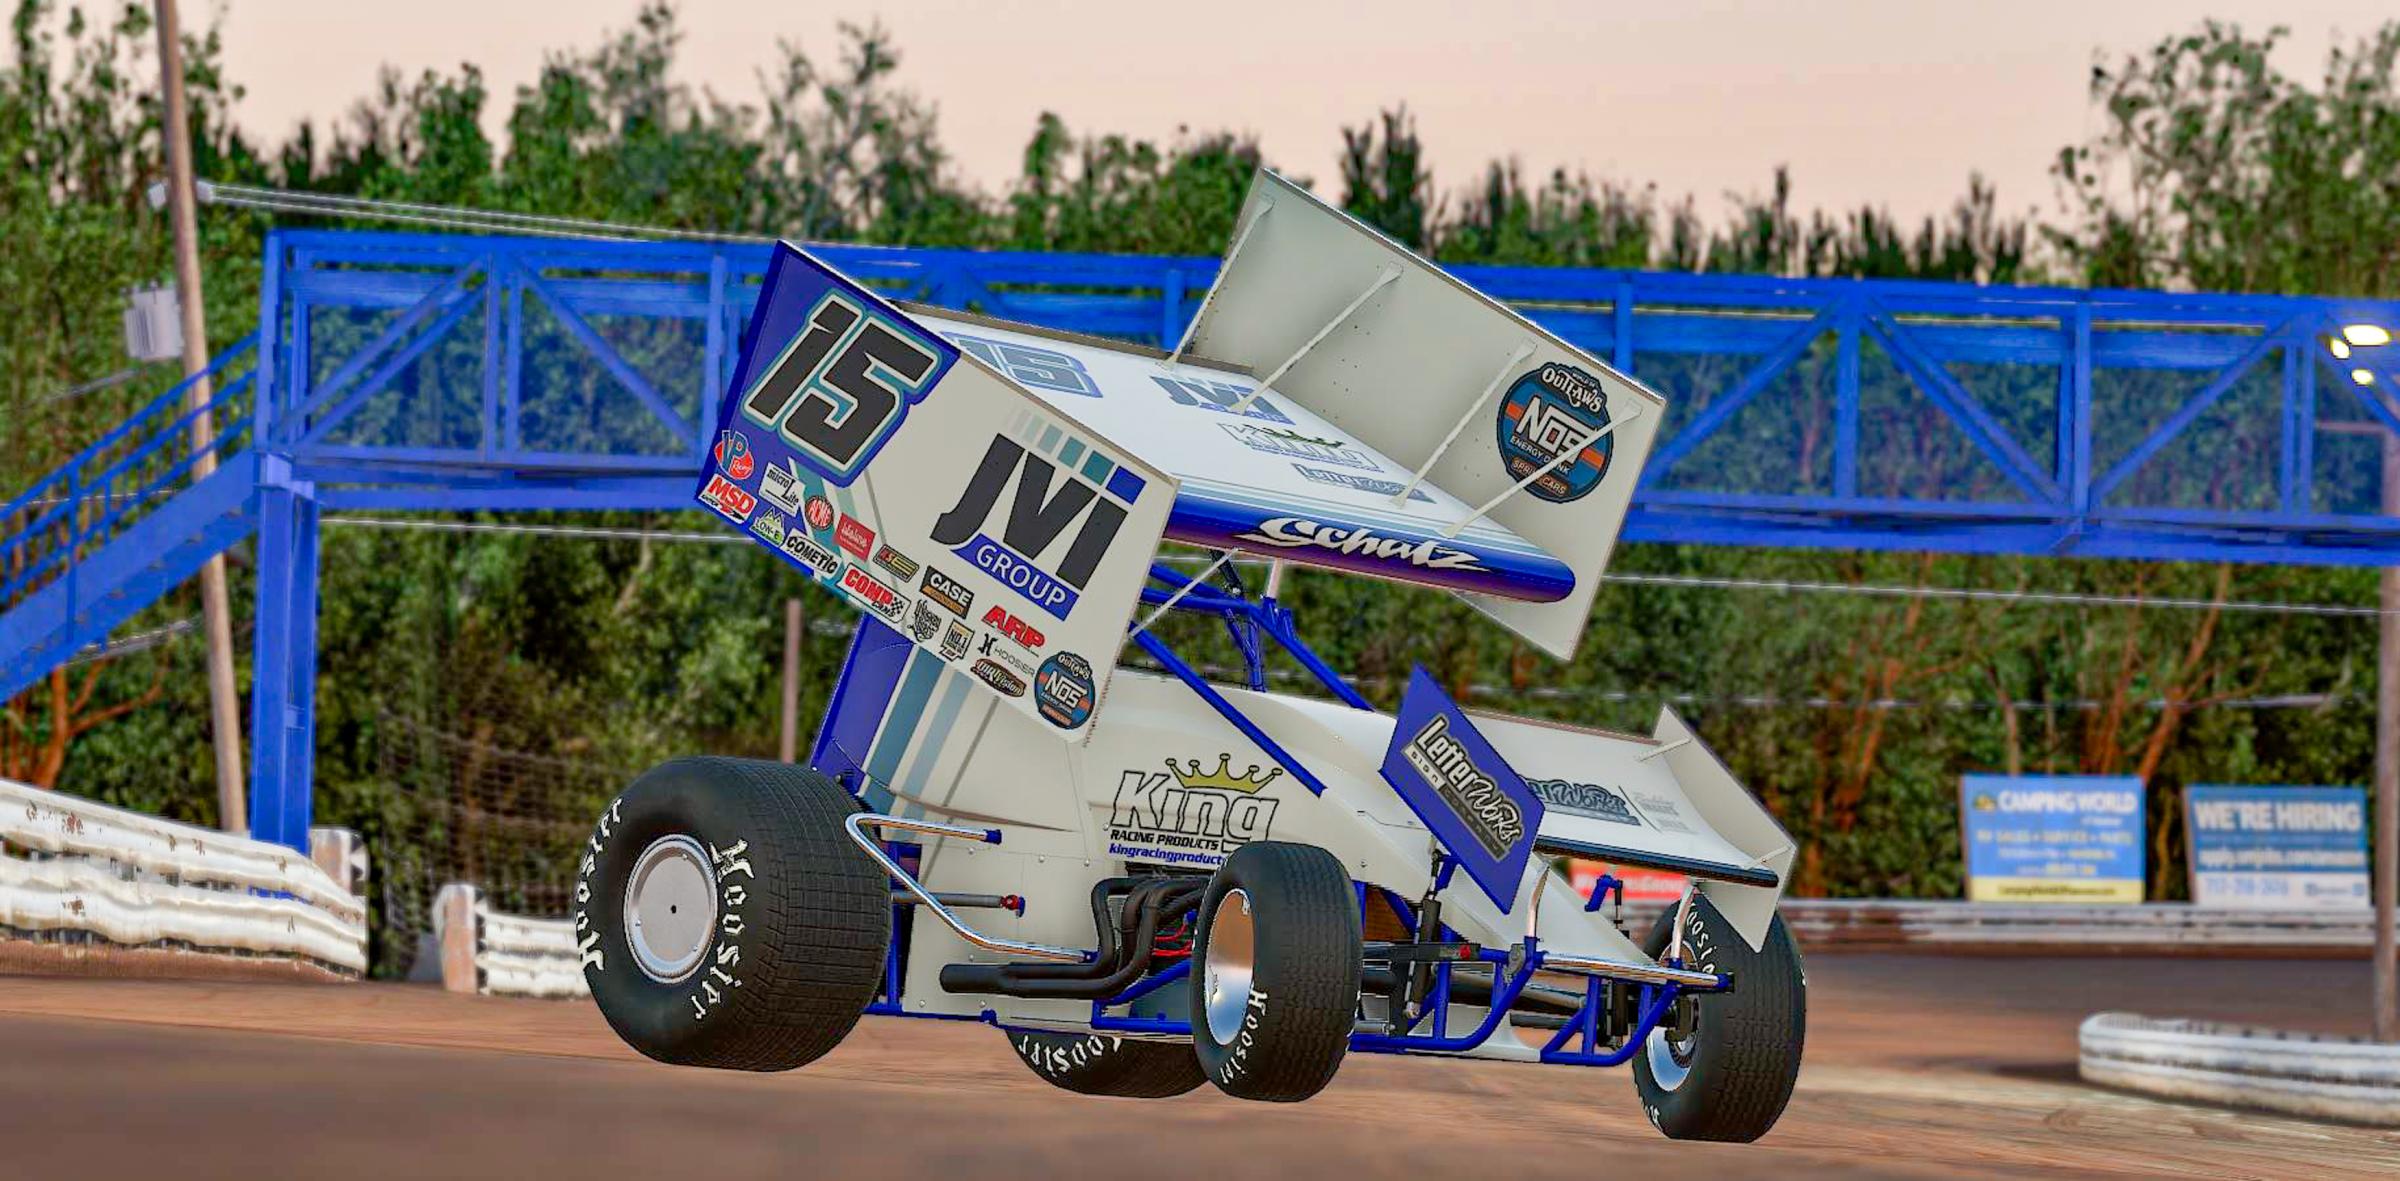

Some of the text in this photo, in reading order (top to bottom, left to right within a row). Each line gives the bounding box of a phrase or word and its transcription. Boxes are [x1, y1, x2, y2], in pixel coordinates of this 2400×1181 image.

[742, 291, 940, 473] 15
[1515, 396, 1598, 465] NOS
[1510, 435, 1571, 474] ENERGY DNK
[706, 476, 756, 515] MSD
[1541, 476, 1567, 494] CARS
[1234, 516, 1492, 573] Schutz
[843, 568, 894, 606] COMP
[930, 572, 972, 608] CASE
[976, 543, 1067, 608] GROUP
[981, 604, 1046, 649] ARP
[1044, 670, 1088, 709] NOS
[1110, 770, 1279, 853] King
[1998, 791, 2138, 813] CAMPING WORLD
[2194, 801, 2362, 832] WE'RE HIRING
[1110, 829, 1219, 850] RACING PRODUCTS
[692, 838, 755, 1020] Hoosier
[1219, 981, 1268, 1084] Hoosier
